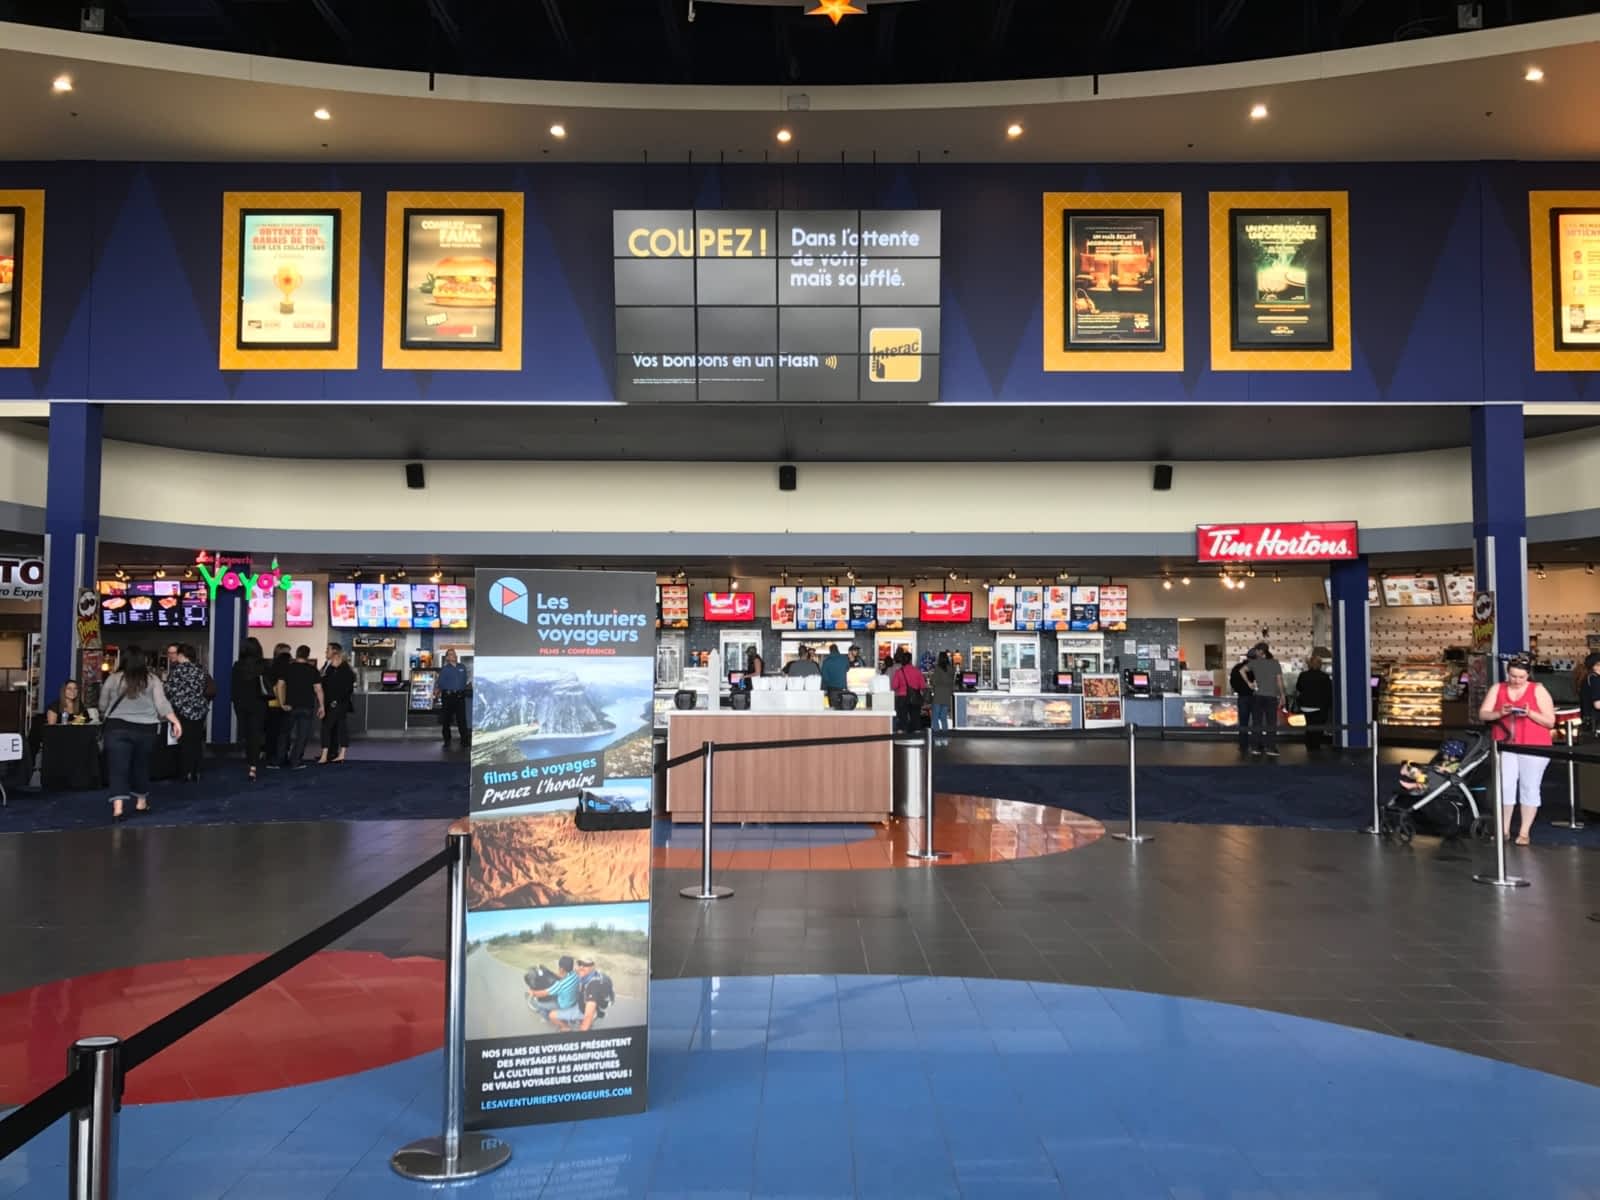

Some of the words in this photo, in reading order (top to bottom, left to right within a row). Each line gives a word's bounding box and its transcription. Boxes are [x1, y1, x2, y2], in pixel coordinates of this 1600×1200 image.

[628, 228, 753, 257] COUPEZ
[761, 228, 767, 257] !
[791, 228, 836, 247] Dans
[790, 269, 833, 287] maïs
[632, 353, 658, 368] Vos
[732, 357, 751, 368] en
[755, 357, 774, 368] un
[1208, 529, 1253, 557] Tim
[196, 558, 293, 601] Yoyo's
[537, 593, 569, 610] Les
[537, 609, 647, 627] aventuriers
[538, 628, 639, 646] voyageurs
[483, 770, 519, 785] films
[523, 766, 538, 780] de
[542, 757, 597, 779] voyages
[482, 785, 531, 805] Prenez
[536, 773, 595, 793] l'horaire
[482, 1050, 500, 1059] NOS
[502, 1048, 527, 1057] FILMS
[529, 1046, 540, 1054] DE
[541, 1042, 579, 1053] VOYAGES
[581, 1037, 632, 1048] PRÉSENTENT
[497, 1059, 514, 1068] DES
[515, 1055, 557, 1067] PAYSAGES
[558, 1050, 618, 1063] MAGNIFIQUES,
[493, 1071, 505, 1080] LA
[506, 1067, 543, 1079] CULTURE
[545, 1066, 555, 1075] ET
[556, 1064, 571, 1074] LES
[572, 1060, 620, 1071] AVENTURES
[482, 1082, 494, 1091] DE
[495, 1080, 520, 1090] VRAIS
[522, 1075, 572, 1088] VOYAGEURS
[573, 1073, 604, 1083] COMME
[605, 1070, 629, 1079] VOUS
[480, 1087, 632, 1110] LESAVENTURIERSVOYAGEURS.COM
